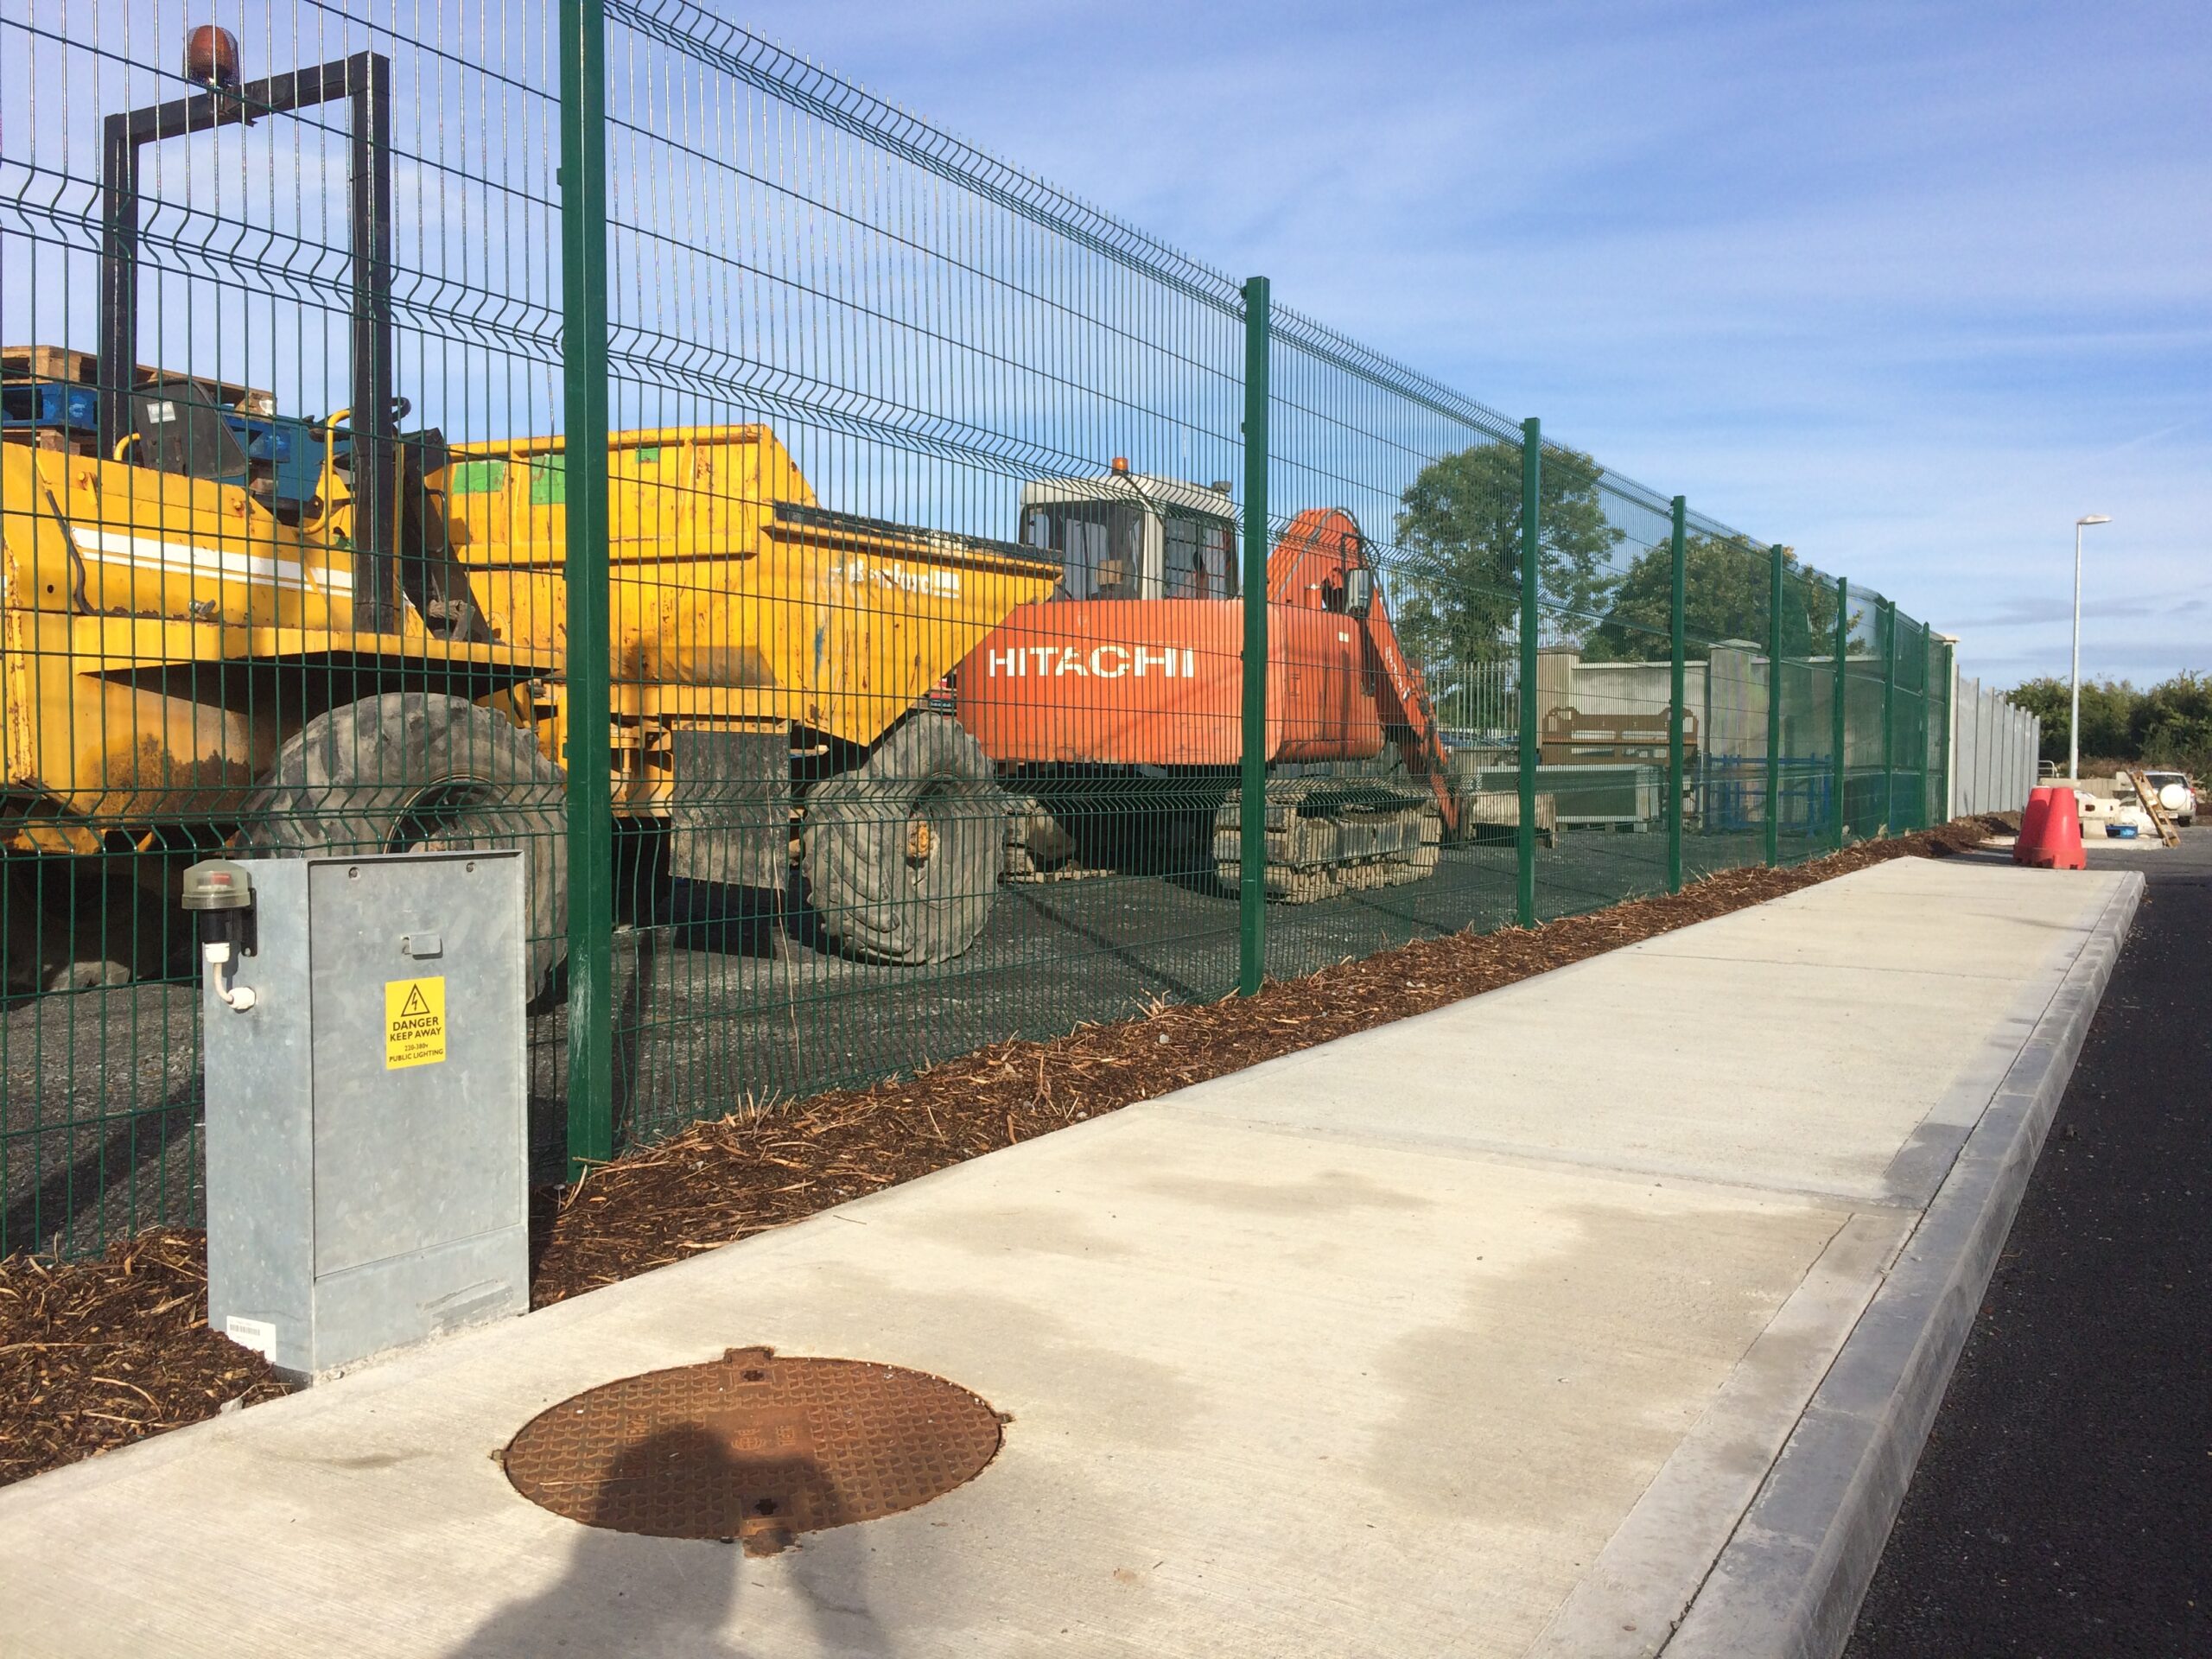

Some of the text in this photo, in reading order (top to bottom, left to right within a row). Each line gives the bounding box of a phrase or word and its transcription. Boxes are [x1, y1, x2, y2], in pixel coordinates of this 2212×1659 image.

[989, 645, 1194, 678] HITACHI
[392, 1016, 439, 1031] DANGER
[390, 1027, 442, 1042] KEEP AWAY
[389, 1048, 443, 1063] PUBLIC LIGHTING
